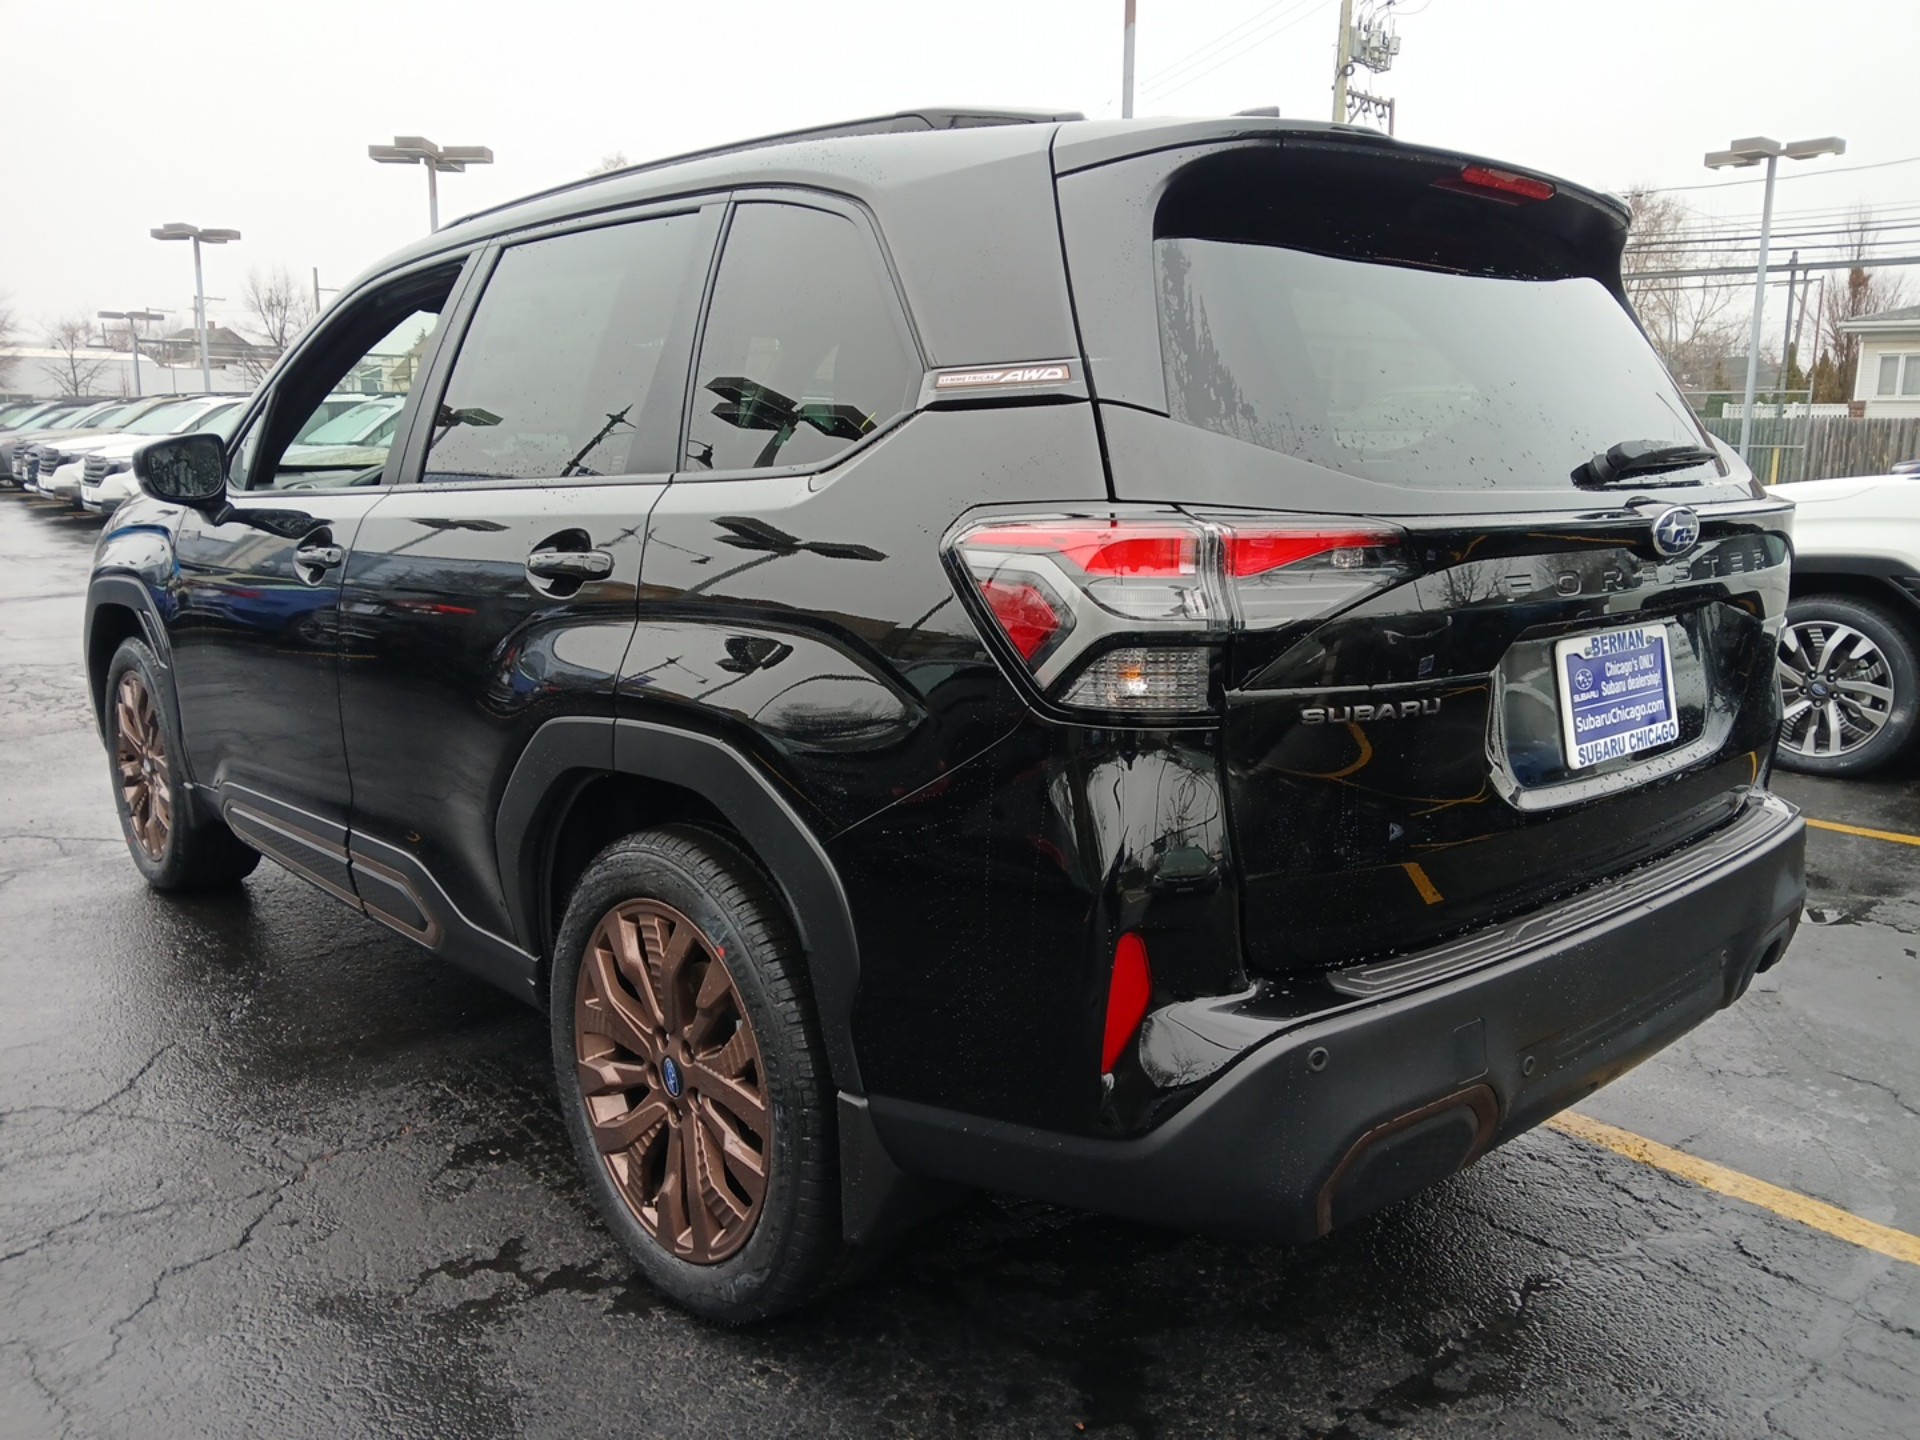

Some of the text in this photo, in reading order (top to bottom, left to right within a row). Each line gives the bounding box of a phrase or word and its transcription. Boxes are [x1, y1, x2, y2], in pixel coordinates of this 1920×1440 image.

[1001, 367, 1064, 382] AWD
[1591, 629, 1645, 656] BERMAN
[1604, 653, 1655, 678] Chicago's ONLY
[1572, 690, 1600, 703] SUBARU
[1601, 670, 1662, 697] Subaru dealership!
[1301, 697, 1442, 725] SUBARU
[1576, 699, 1665, 733] SubaruChicago.com
[1578, 722, 1677, 766] SUBARU CHICAGO
